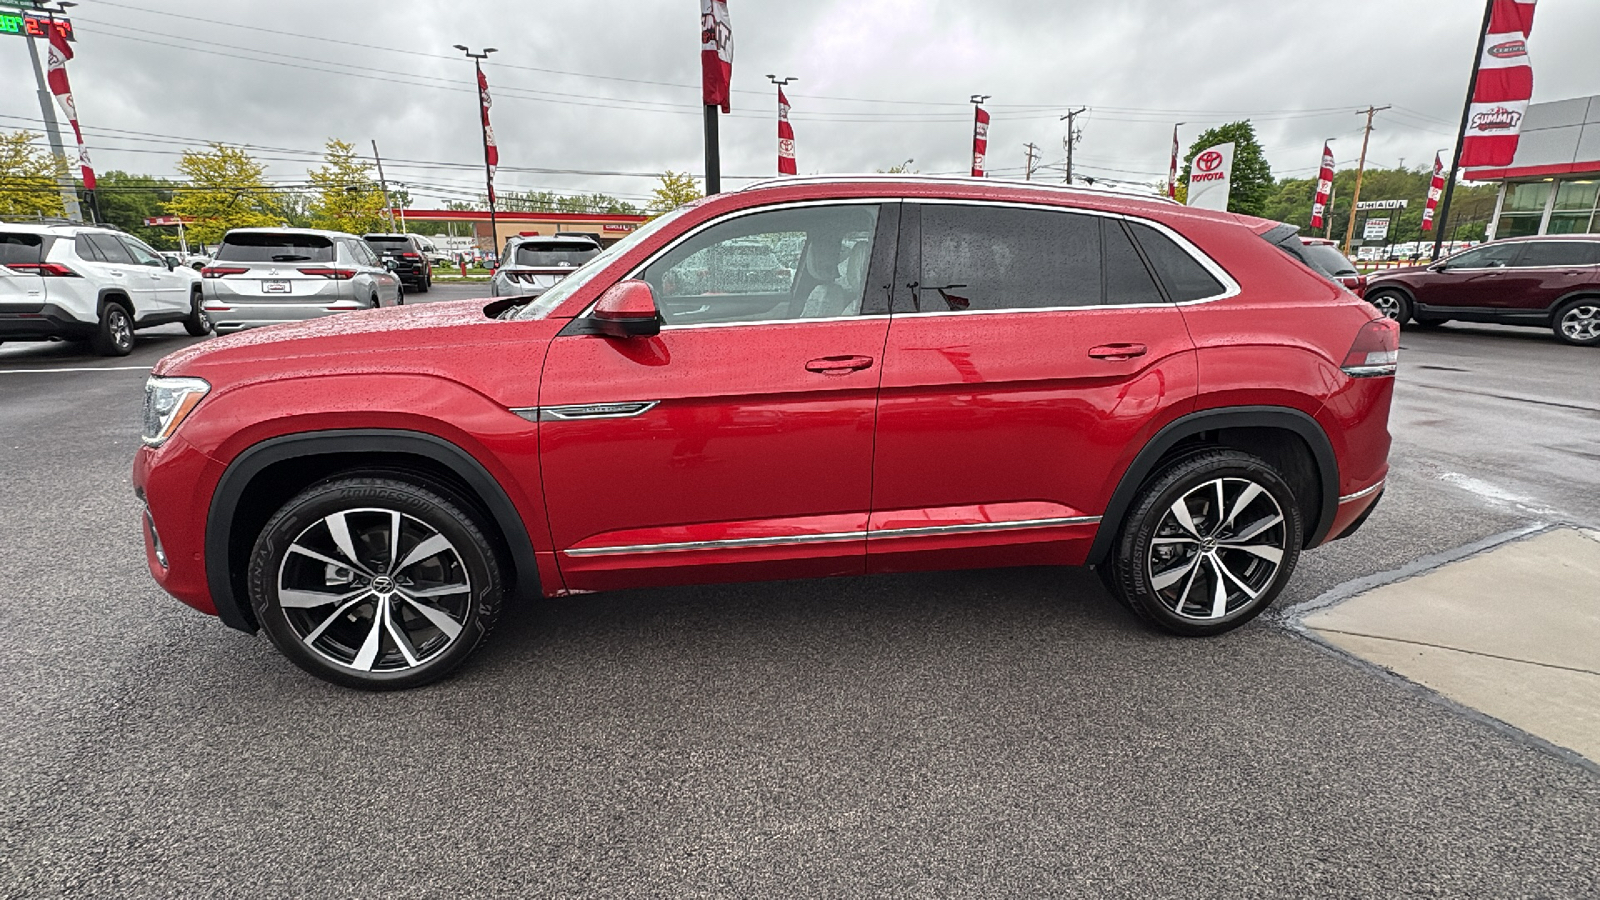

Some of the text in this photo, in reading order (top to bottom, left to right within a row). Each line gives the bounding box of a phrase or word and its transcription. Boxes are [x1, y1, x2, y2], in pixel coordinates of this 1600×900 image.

[1471, 111, 1521, 129] SUMMIT
[1191, 172, 1224, 182] TOYOTA
[1133, 524, 1150, 595] BRIDGESTONE
